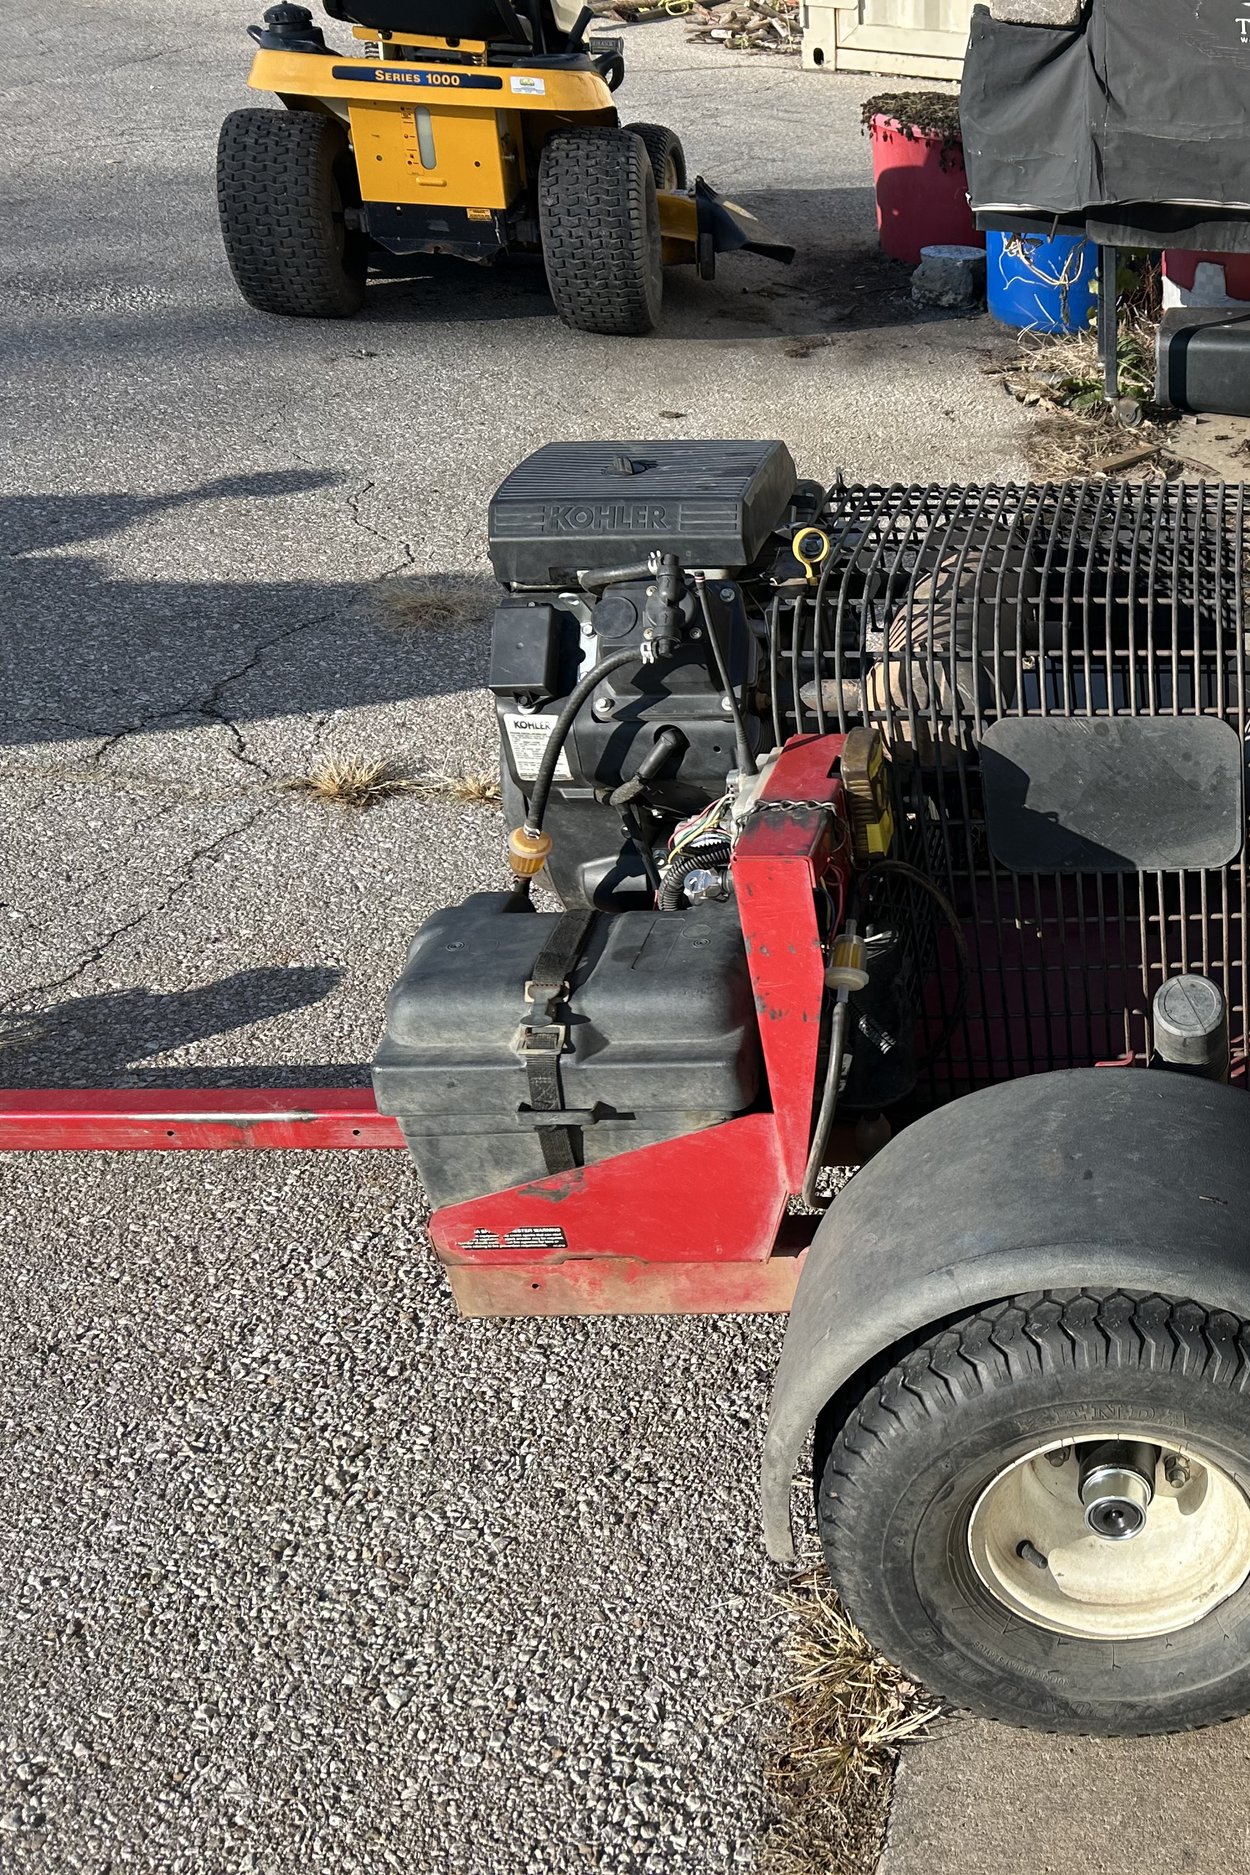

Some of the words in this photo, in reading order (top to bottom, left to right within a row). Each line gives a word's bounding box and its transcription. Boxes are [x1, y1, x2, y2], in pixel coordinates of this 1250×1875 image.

[425, 73, 461, 87] 1000
[549, 504, 673, 532] KOHLER
[513, 719, 551, 731] KOHLER
[1014, 1403, 1189, 1434] KENDA
